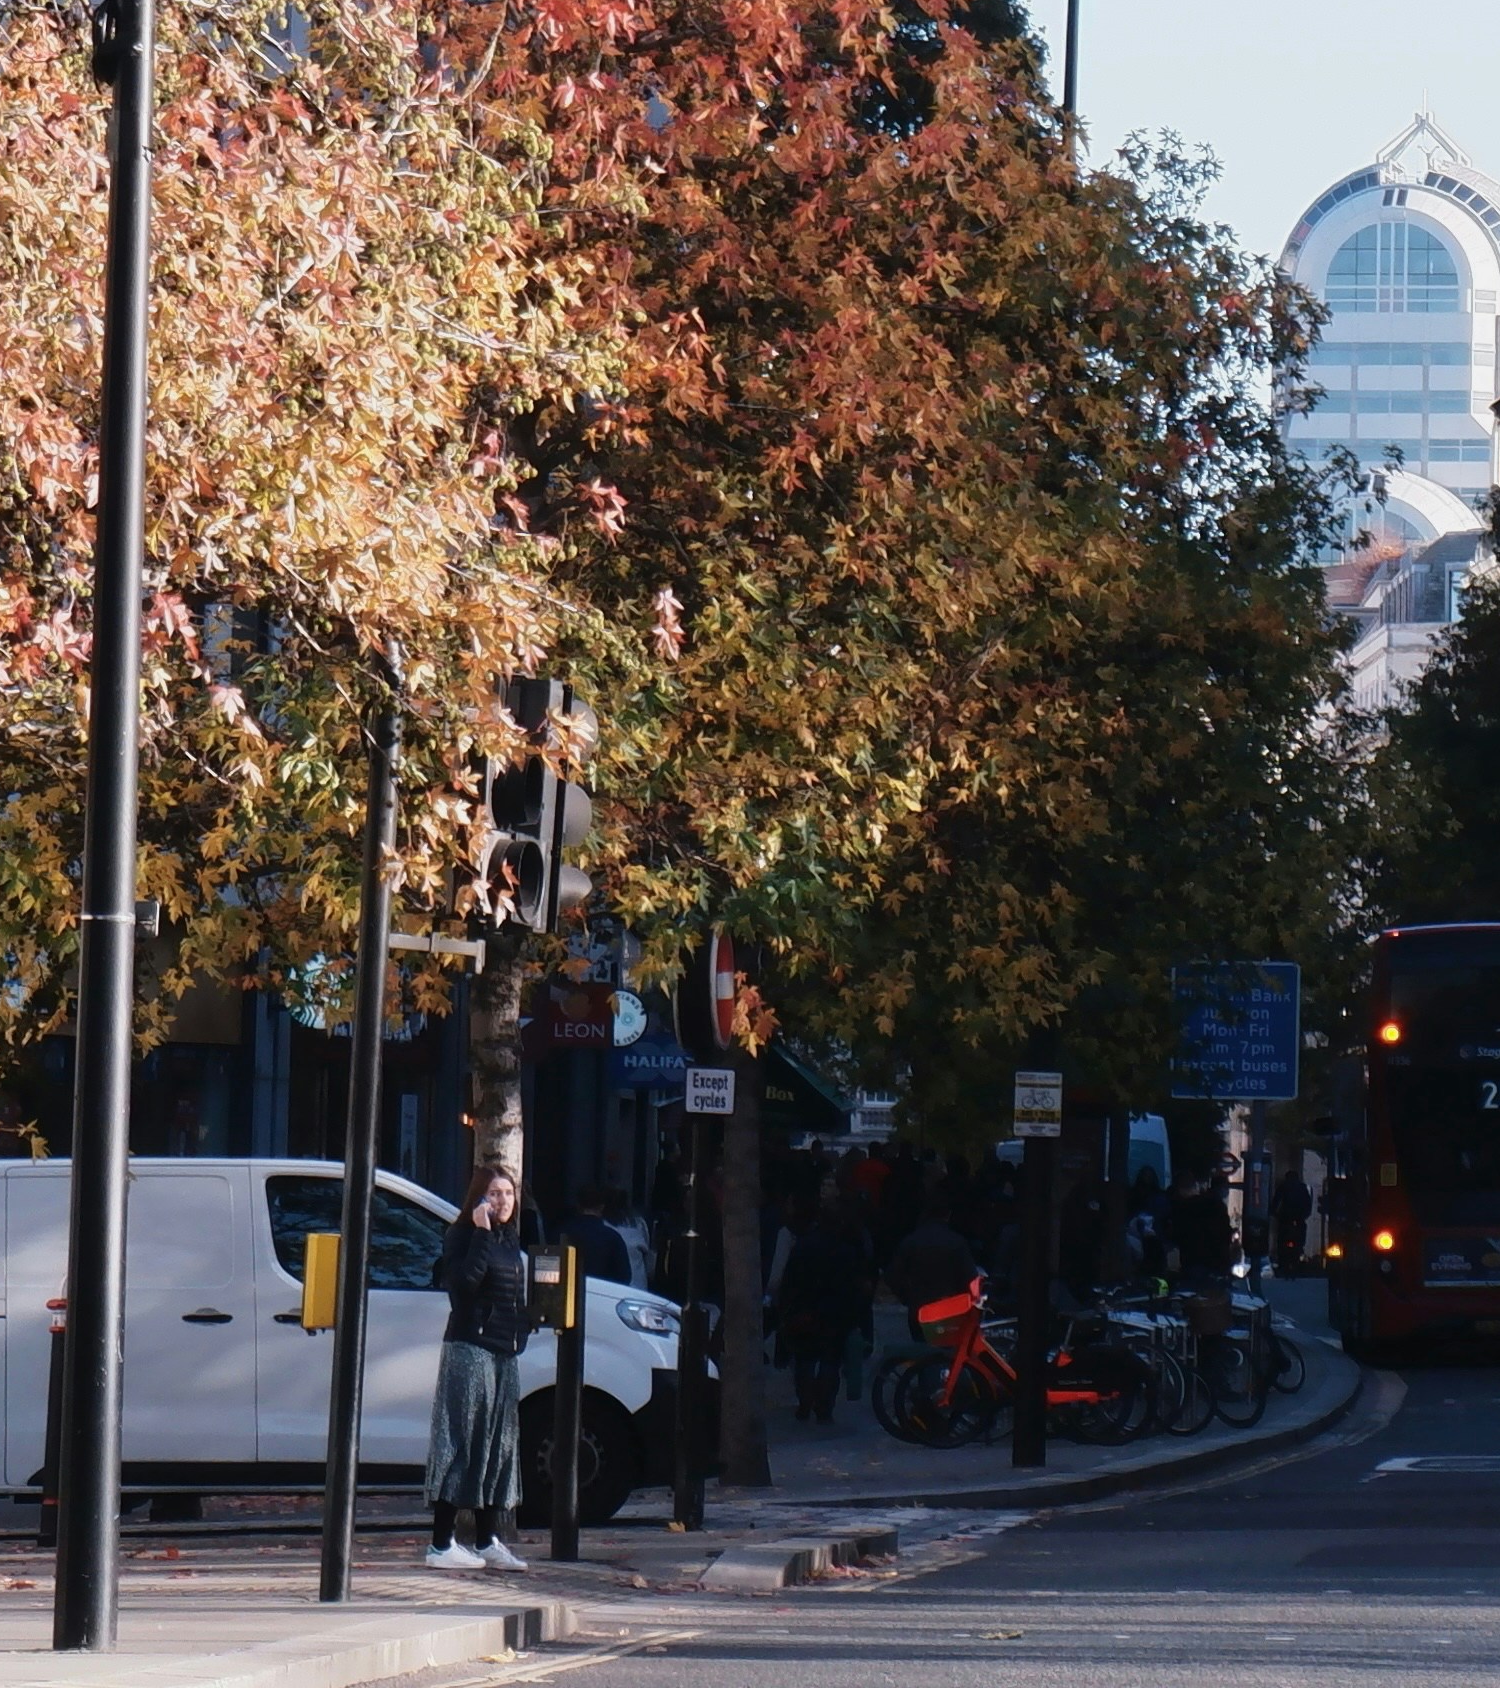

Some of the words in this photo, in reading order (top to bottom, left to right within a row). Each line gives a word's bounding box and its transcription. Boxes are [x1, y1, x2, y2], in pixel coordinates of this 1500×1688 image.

[1251, 988, 1292, 1003] Bank
[554, 1022, 606, 1038] LEON
[1241, 1058, 1288, 1073] buses
[693, 1072, 728, 1092] Except
[1218, 1076, 1267, 1092] cycles
[694, 1092, 726, 1111] cycles
[765, 1085, 795, 1102] Box
